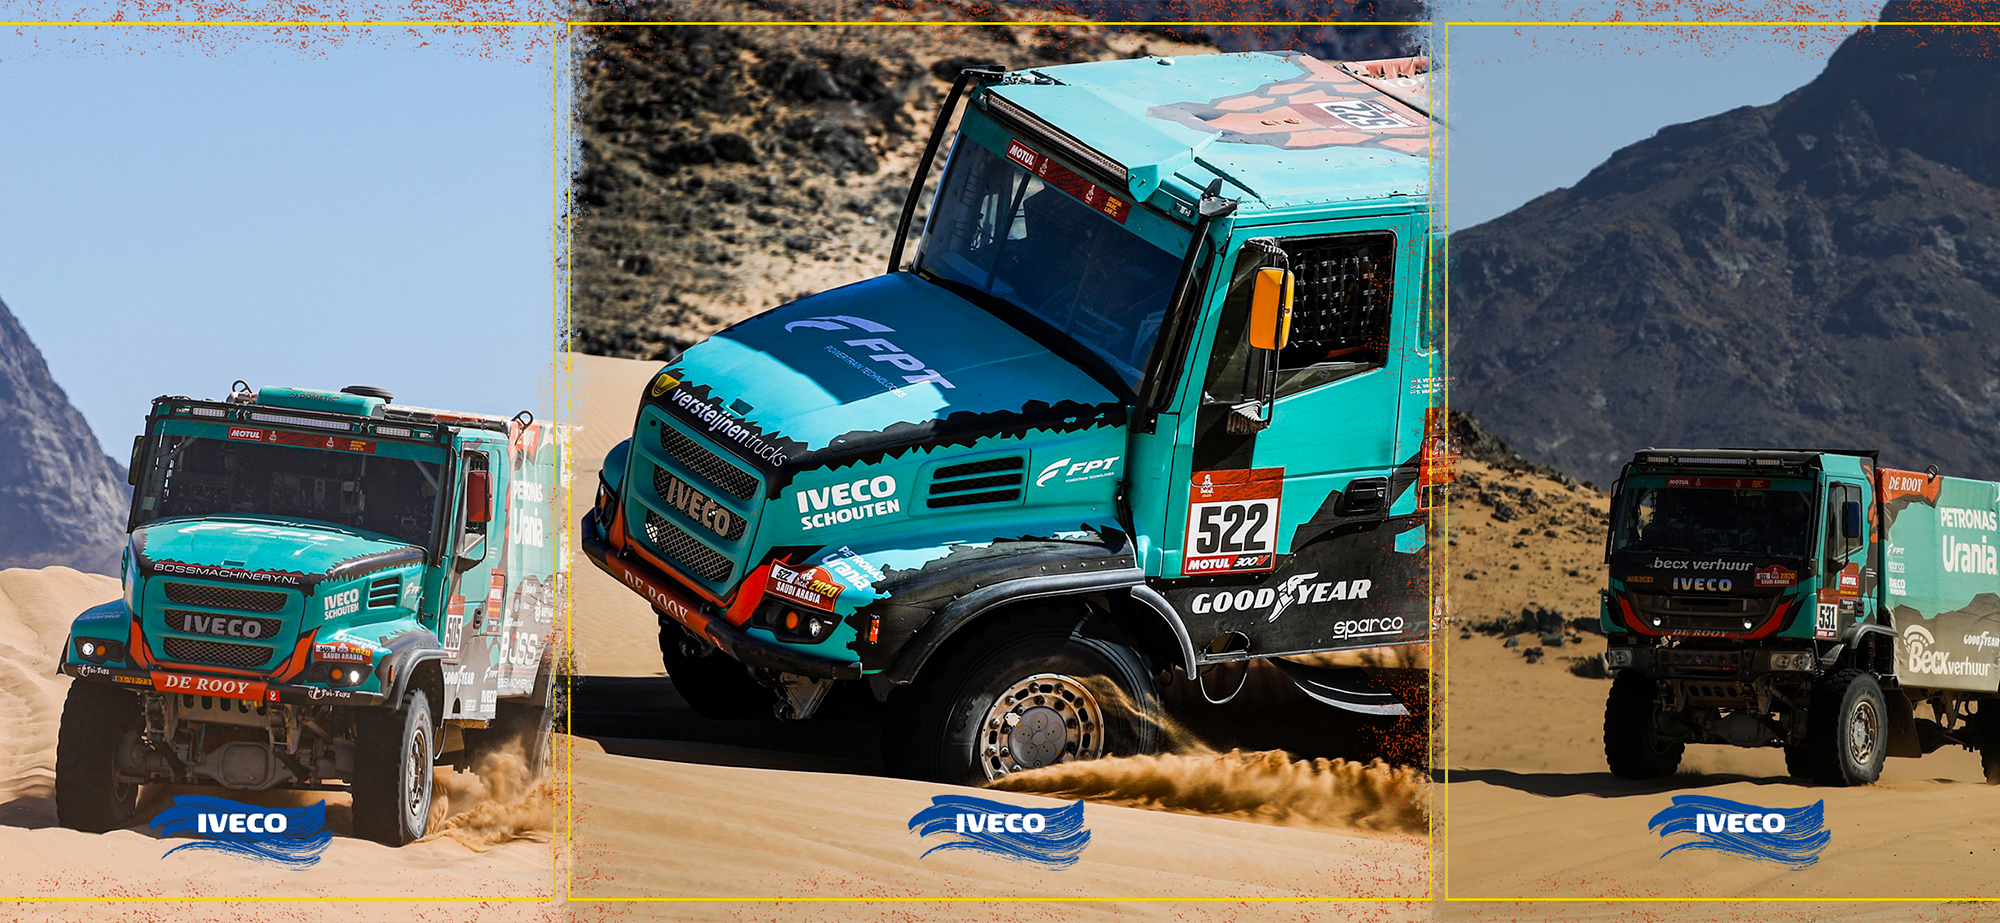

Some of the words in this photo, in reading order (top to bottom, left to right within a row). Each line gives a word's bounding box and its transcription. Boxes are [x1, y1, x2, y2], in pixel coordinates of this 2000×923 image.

[1009, 144, 1035, 166] MOTUL
[843, 337, 957, 389] FPT
[231, 429, 261, 439] MOTUL
[1066, 456, 1120, 476] FPT
[796, 474, 897, 513] IVECO
[1888, 476, 1900, 490] DE
[1901, 478, 1923, 492] ROOY
[666, 476, 730, 537] IVECO
[801, 498, 900, 530] SCHOUTEN
[513, 508, 544, 548] Urania
[1196, 503, 1269, 554] 522
[1941, 507, 1998, 532] PETRONAS
[838, 545, 887, 582] PETRONAS
[1187, 558, 1230, 571] MOTUL
[1233, 555, 1270, 568] 300V
[1653, 557, 1690, 570] becx
[1692, 558, 1753, 572] verhuur
[1942, 535, 1998, 576] Urania
[153, 563, 300, 585] BOSSMACHINERY.NL
[775, 568, 792, 581] 522
[822, 553, 872, 591] Urania
[1888, 577, 1906, 589] IVECO
[776, 581, 796, 597] SAUDI
[795, 587, 821, 604] ARABIA
[809, 579, 838, 598] 2020
[1672, 577, 1732, 592] IVECO
[324, 588, 359, 610] IVECO
[324, 602, 359, 620] SCHOUTEN
[1819, 605, 1836, 630] 531
[183, 615, 262, 638] IVECO
[446, 617, 462, 648] 505
[1332, 616, 1404, 640] sparco
[1672, 629, 1690, 637] DE
[1693, 629, 1729, 638] ROOY
[350, 647, 371, 657] 2020
[165, 675, 192, 690] DE
[196, 677, 250, 694] ROOY
[480, 690, 497, 703] IVECO
